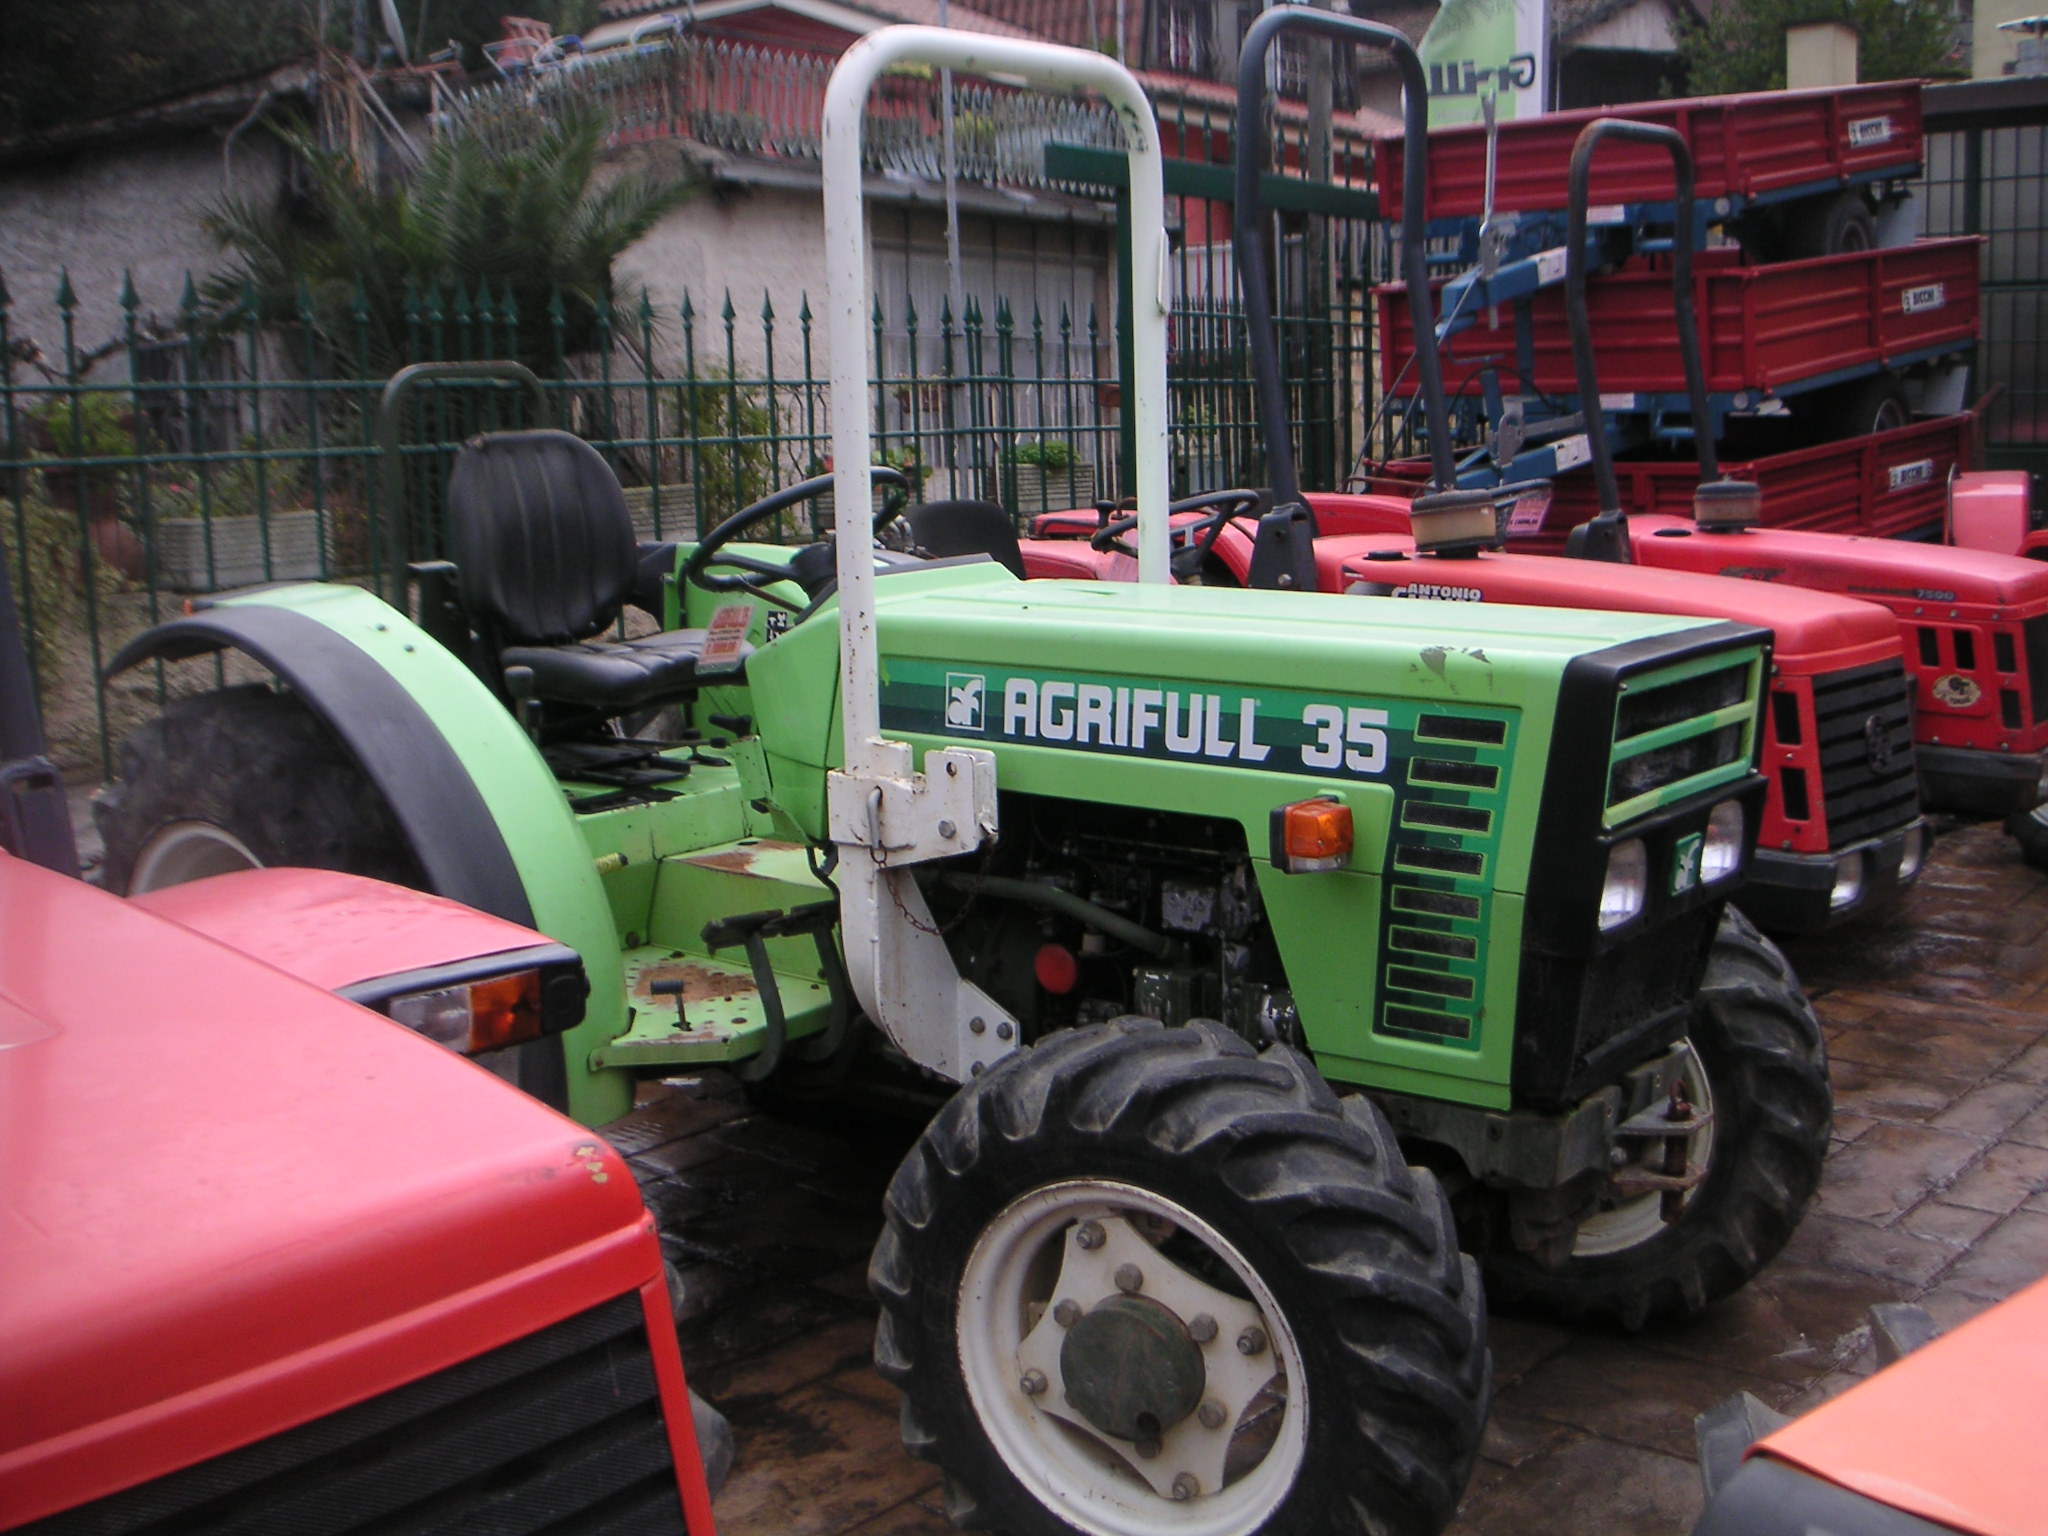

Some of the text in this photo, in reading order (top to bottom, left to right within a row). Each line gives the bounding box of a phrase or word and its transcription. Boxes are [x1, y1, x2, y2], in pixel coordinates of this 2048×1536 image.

[1408, 583, 1482, 601] ANTONIO
[1917, 588, 1955, 601] 7500
[1004, 678, 1389, 774] AGRIFULL 35
